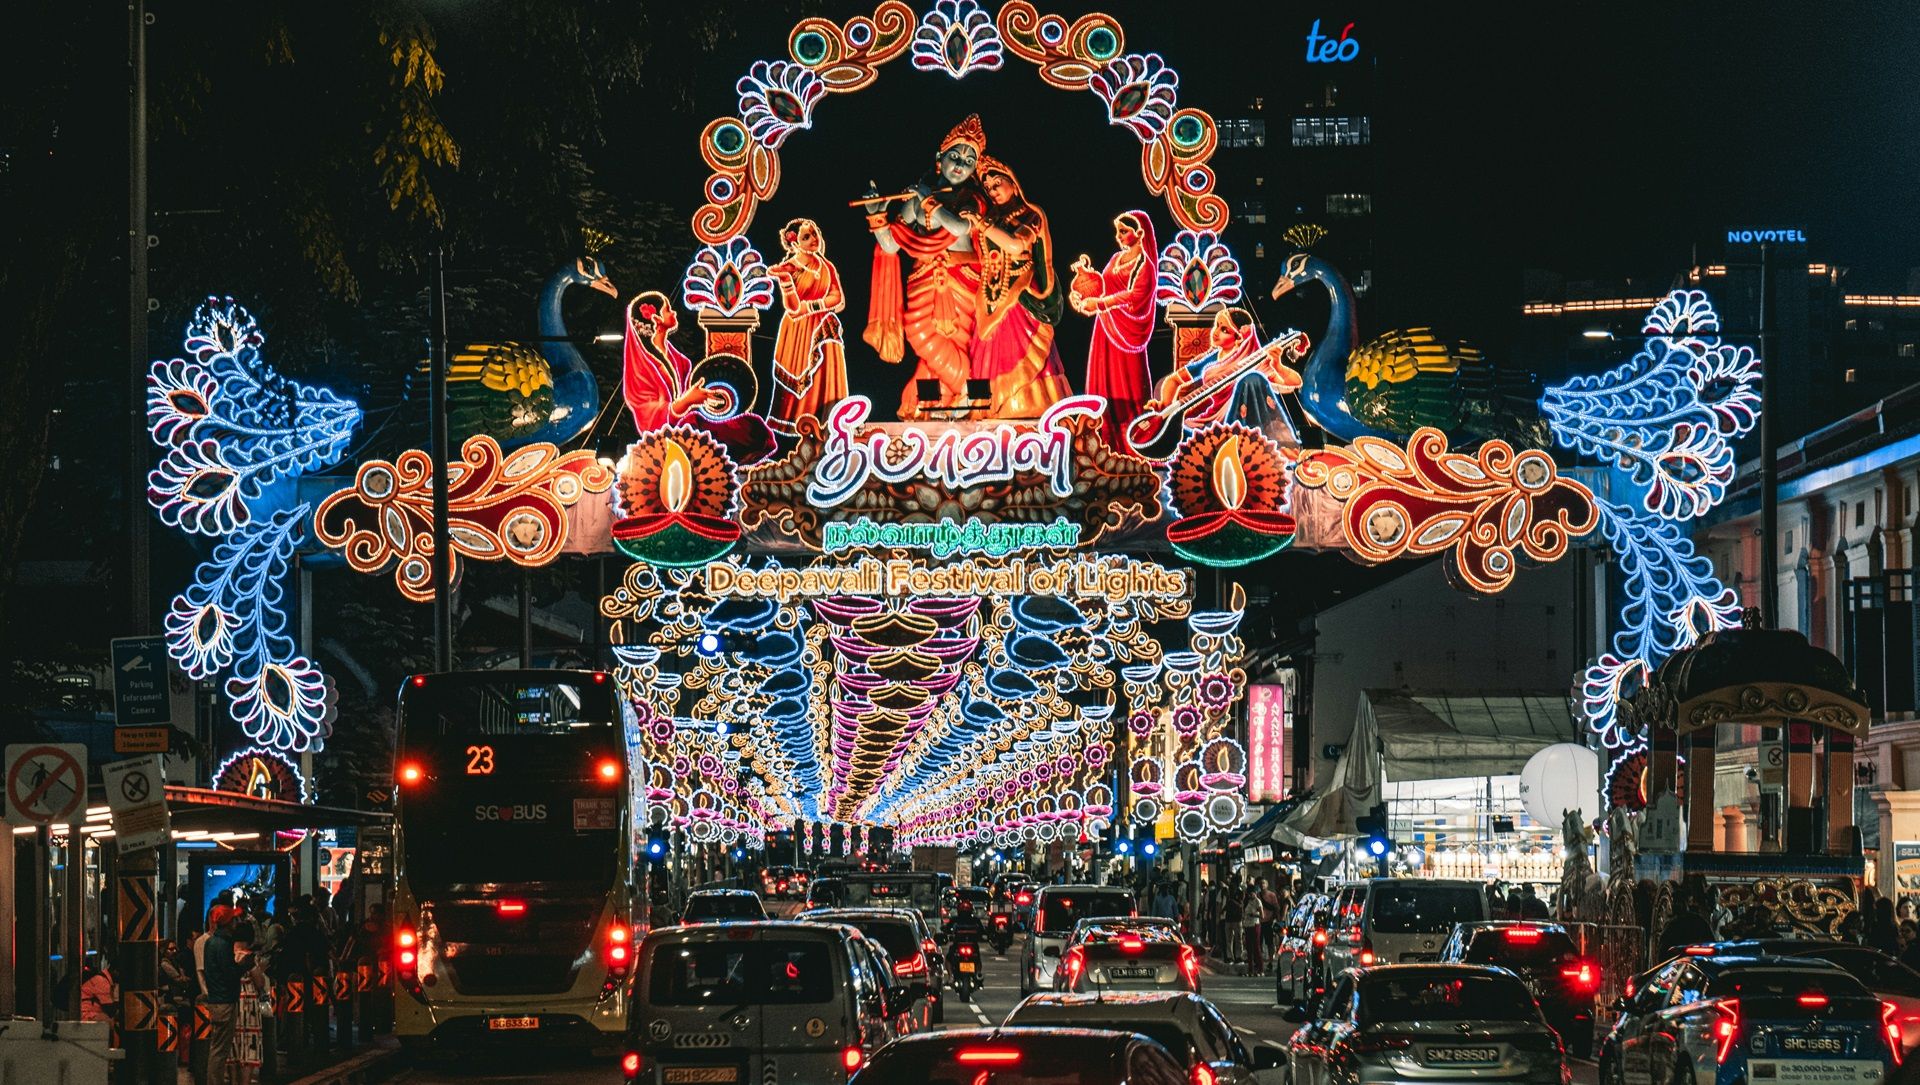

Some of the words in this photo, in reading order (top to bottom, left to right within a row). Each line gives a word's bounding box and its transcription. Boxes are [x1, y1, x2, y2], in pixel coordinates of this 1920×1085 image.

[1727, 229, 1807, 243] NOVOTEL
[807, 396, 1106, 506] தீபாவளி
[706, 558, 882, 603] Deepavali
[886, 559, 1024, 597] Festival
[1029, 559, 1071, 596] of
[1076, 560, 1186, 605] Lights
[129, 680, 154, 690] Parking
[122, 693, 162, 703] Enforcement
[131, 706, 156, 715] Camera
[1271, 702, 1281, 745] ANANDA
[467, 745, 494, 774] 23
[1271, 746, 1281, 791] BHAVAN
[475, 804, 500, 821] SG
[512, 804, 547, 820] BUS
[492, 1018, 536, 1029] SG6333M
[654, 1024, 669, 1034] 70
[1792, 1064, 1820, 1073] 30,000
